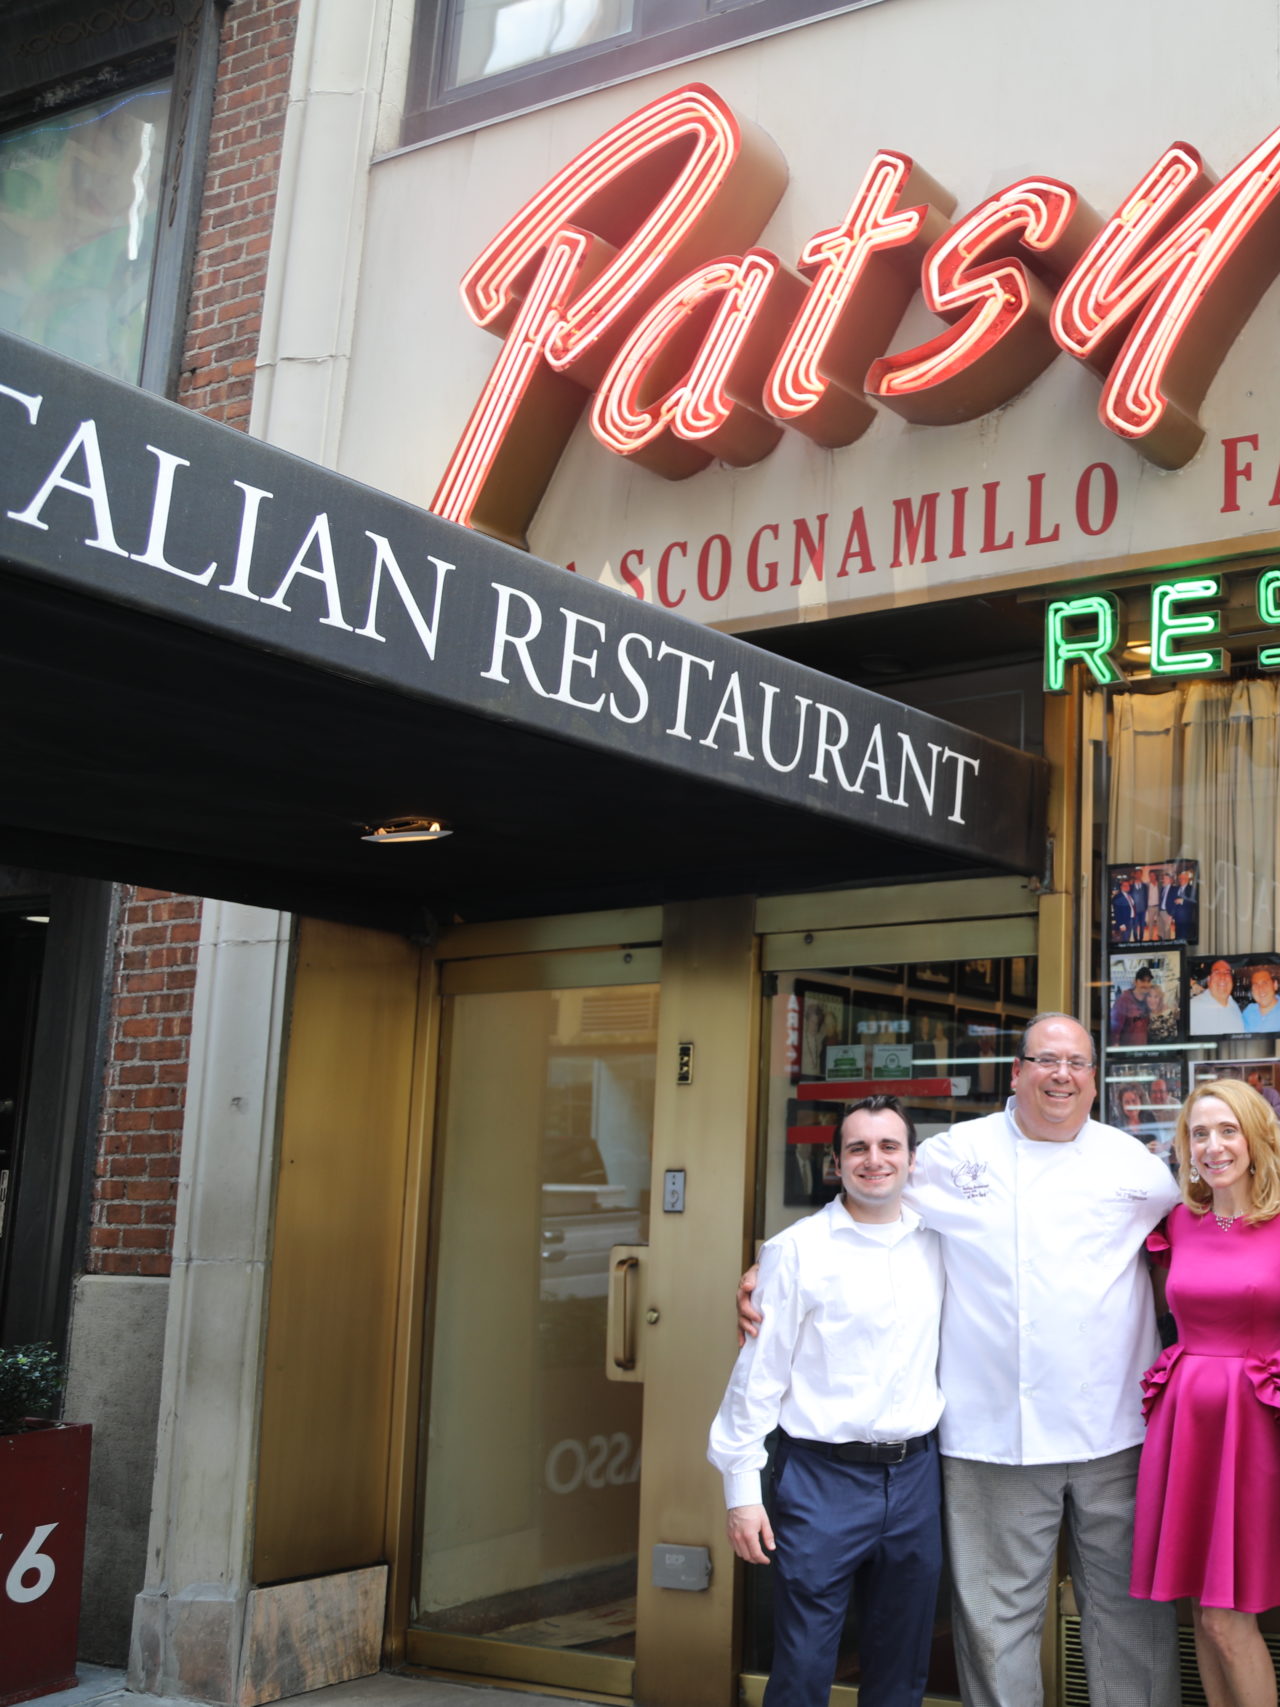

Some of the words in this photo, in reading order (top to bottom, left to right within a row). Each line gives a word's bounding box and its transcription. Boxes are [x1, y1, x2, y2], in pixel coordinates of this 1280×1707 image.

[0, 384, 457, 662] ALIAN
[480, 581, 981, 826] RESTAURANT
[619, 461, 1119, 608] SCOGNAMILLO
[0, 1521, 60, 1604] 6
